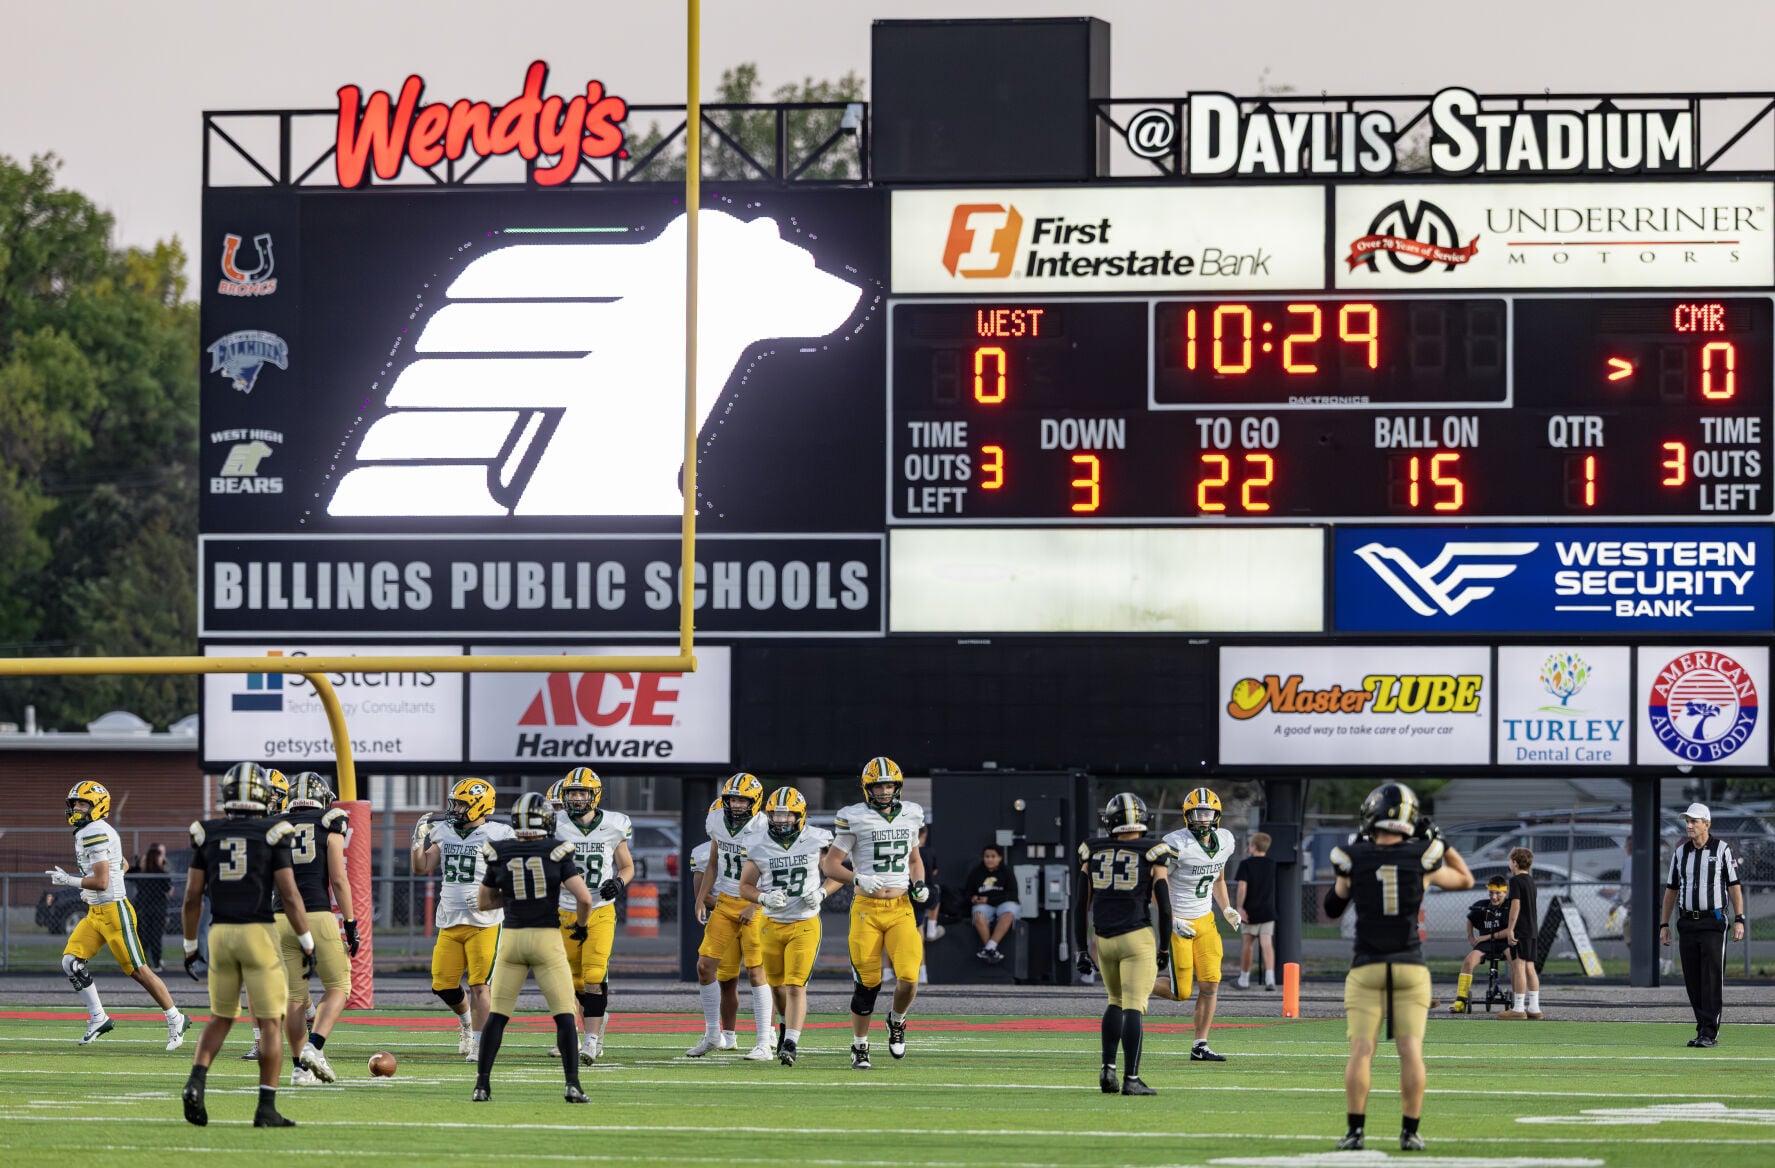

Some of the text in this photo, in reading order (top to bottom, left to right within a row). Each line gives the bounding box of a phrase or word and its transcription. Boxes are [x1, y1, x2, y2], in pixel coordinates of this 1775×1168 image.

[337, 60, 627, 188] Wendy's
[1127, 88, 1693, 175] @ DAYLIS STADIUM
[1032, 217, 1112, 244] First
[1485, 206, 1764, 233] UNDERRINER
[1025, 248, 1271, 277] Interstate Bank
[1357, 238, 1467, 262] Over 70 Years of Service
[976, 309, 1044, 337] WEST
[1674, 303, 1725, 332] CMR
[1186, 303, 1379, 374] 10:29
[974, 346, 1006, 404] 0
[1702, 341, 1735, 399] 0
[1288, 395, 1370, 405] DAKTRONICS
[210, 429, 284, 444] WEST HIGH
[907, 421, 968, 448] TIME
[1040, 418, 1126, 450] DOWN
[1195, 416, 1280, 449] TO GO
[1374, 415, 1479, 448] BALL ON
[1547, 415, 1605, 447] QTR
[1699, 417, 1761, 443] TIME
[904, 454, 972, 481] OUTS
[981, 445, 1004, 489] 3
[1662, 441, 1686, 486] 3
[1692, 450, 1762, 477] OUTS
[210, 477, 284, 494] BEARS
[1071, 455, 1100, 511] 3
[1197, 454, 1274, 511] 22
[1409, 453, 1464, 511] 15
[1585, 455, 1596, 507] 1
[907, 487, 968, 513] LEFT
[1699, 484, 1761, 511] LEFT
[1554, 542, 1756, 566] WESTERN
[214, 561, 870, 610] BILLINGS PUBLIC SCHOOLS
[1554, 571, 1755, 595] SECURITY
[1615, 600, 1694, 617] BANK
[1653, 651, 1756, 699] AMERICAN
[361, 699, 435, 714] Consultants
[517, 663, 683, 728] ACE
[1274, 724, 1454, 737] A good way to take care of your car
[1502, 719, 1625, 741] TURLEY
[1652, 711, 1756, 760] AUTO BODY
[515, 733, 674, 758] Hardware
[1516, 747, 1613, 761] Dental Care
[443, 843, 479, 856] RUSTLERS
[573, 842, 606, 853] STLERS
[717, 839, 742, 855] RUSTLE
[872, 829, 911, 843] RUSTLERS
[218, 836, 248, 881] 3
[723, 852, 743, 881] 11
[769, 854, 809, 870] RUSTLERS
[872, 841, 908, 873] 52
[1091, 848, 1140, 891] 33
[506, 856, 548, 900] 11
[771, 866, 808, 898] 59
[1375, 864, 1399, 916] 1
